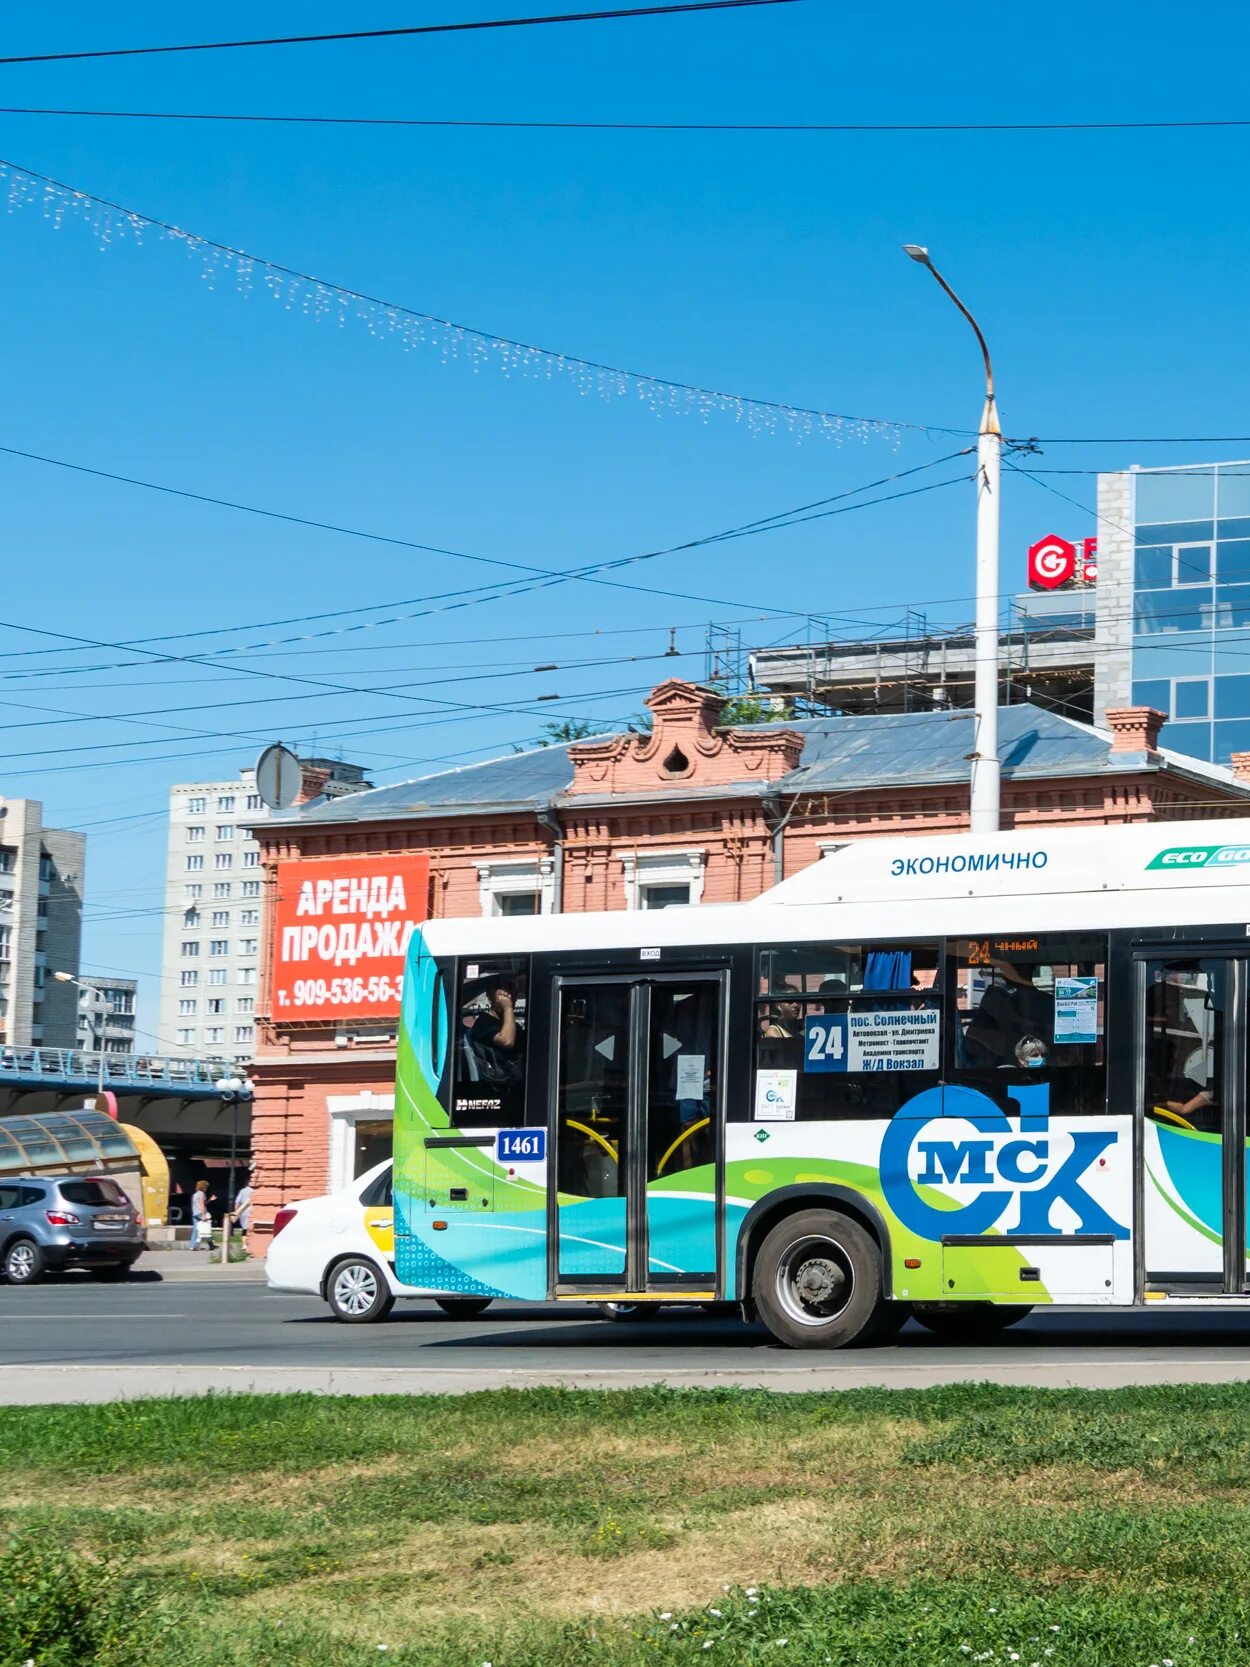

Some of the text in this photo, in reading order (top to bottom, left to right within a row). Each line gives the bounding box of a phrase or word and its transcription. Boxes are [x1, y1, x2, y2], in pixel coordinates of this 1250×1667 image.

[891, 851, 1048, 876] ЭКОНОМИЧНО
[296, 875, 407, 919] АРЕНДА
[281, 920, 415, 967] ПРОДАЖА
[968, 941, 990, 964] 24
[850, 1012, 937, 1027] пос. Солнечный
[808, 1026, 844, 1060] 24
[863, 1059, 925, 1070] Ж/Д Вокзал
[468, 1099, 501, 1110] NEFAZ
[503, 1136, 540, 1155] 1461
